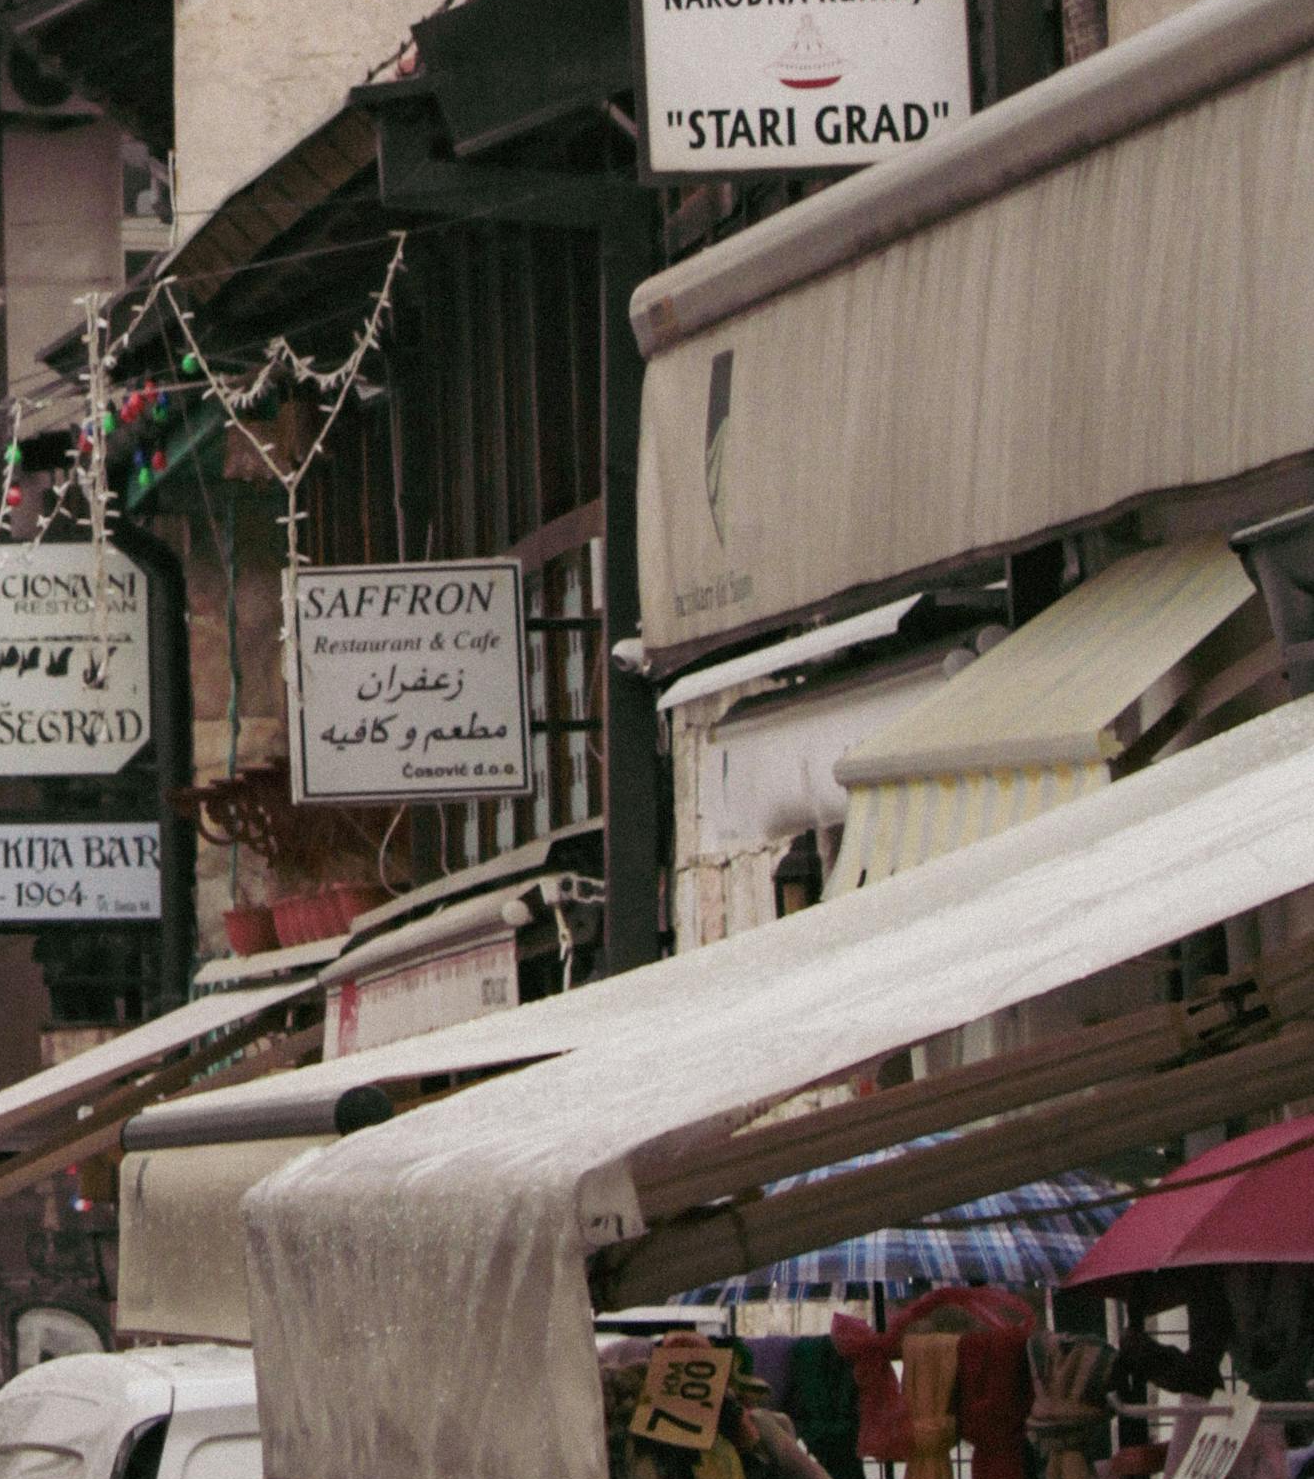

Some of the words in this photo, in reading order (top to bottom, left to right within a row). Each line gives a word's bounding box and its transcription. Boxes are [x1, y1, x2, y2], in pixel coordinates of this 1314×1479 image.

[666, 106, 796, 150] "STARI
[814, 101, 950, 144] GRAD"
[14, 599, 137, 615] RESTOAN
[304, 581, 495, 620] SAFFRON
[313, 634, 422, 655] Restaurant
[429, 632, 447, 652] &
[453, 629, 501, 654] Cafe
[357, 663, 465, 703] زعفران
[423, 711, 508, 752] مطعم
[82, 834, 161, 870] BAR
[15, 881, 87, 908] 1964
